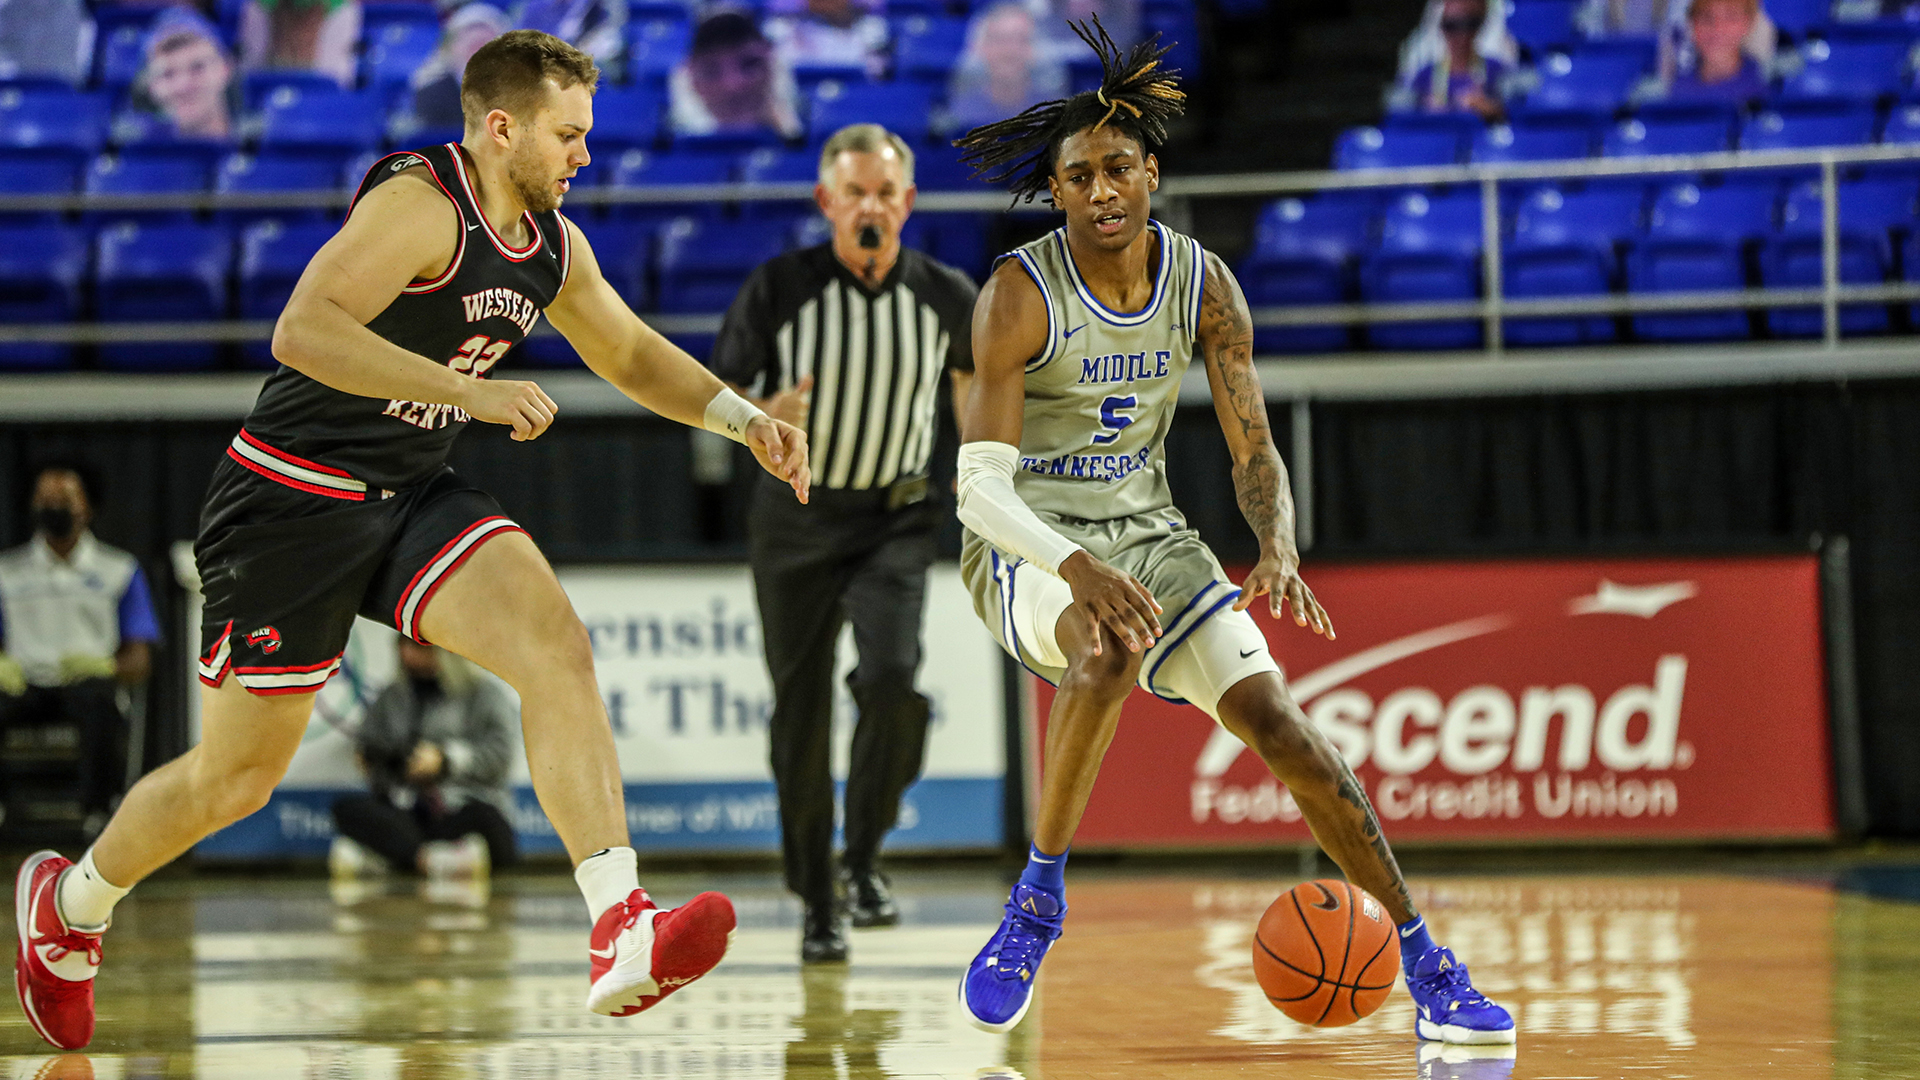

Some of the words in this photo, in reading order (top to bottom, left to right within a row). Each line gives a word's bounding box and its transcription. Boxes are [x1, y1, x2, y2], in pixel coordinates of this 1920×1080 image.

[447, 334, 512, 380] 22
[381, 399, 471, 430] KENTU
[1089, 393, 1139, 446] 5
[1191, 778, 1305, 824] Fede
[1376, 774, 1524, 821] Credit
[1533, 772, 1679, 819] Union
